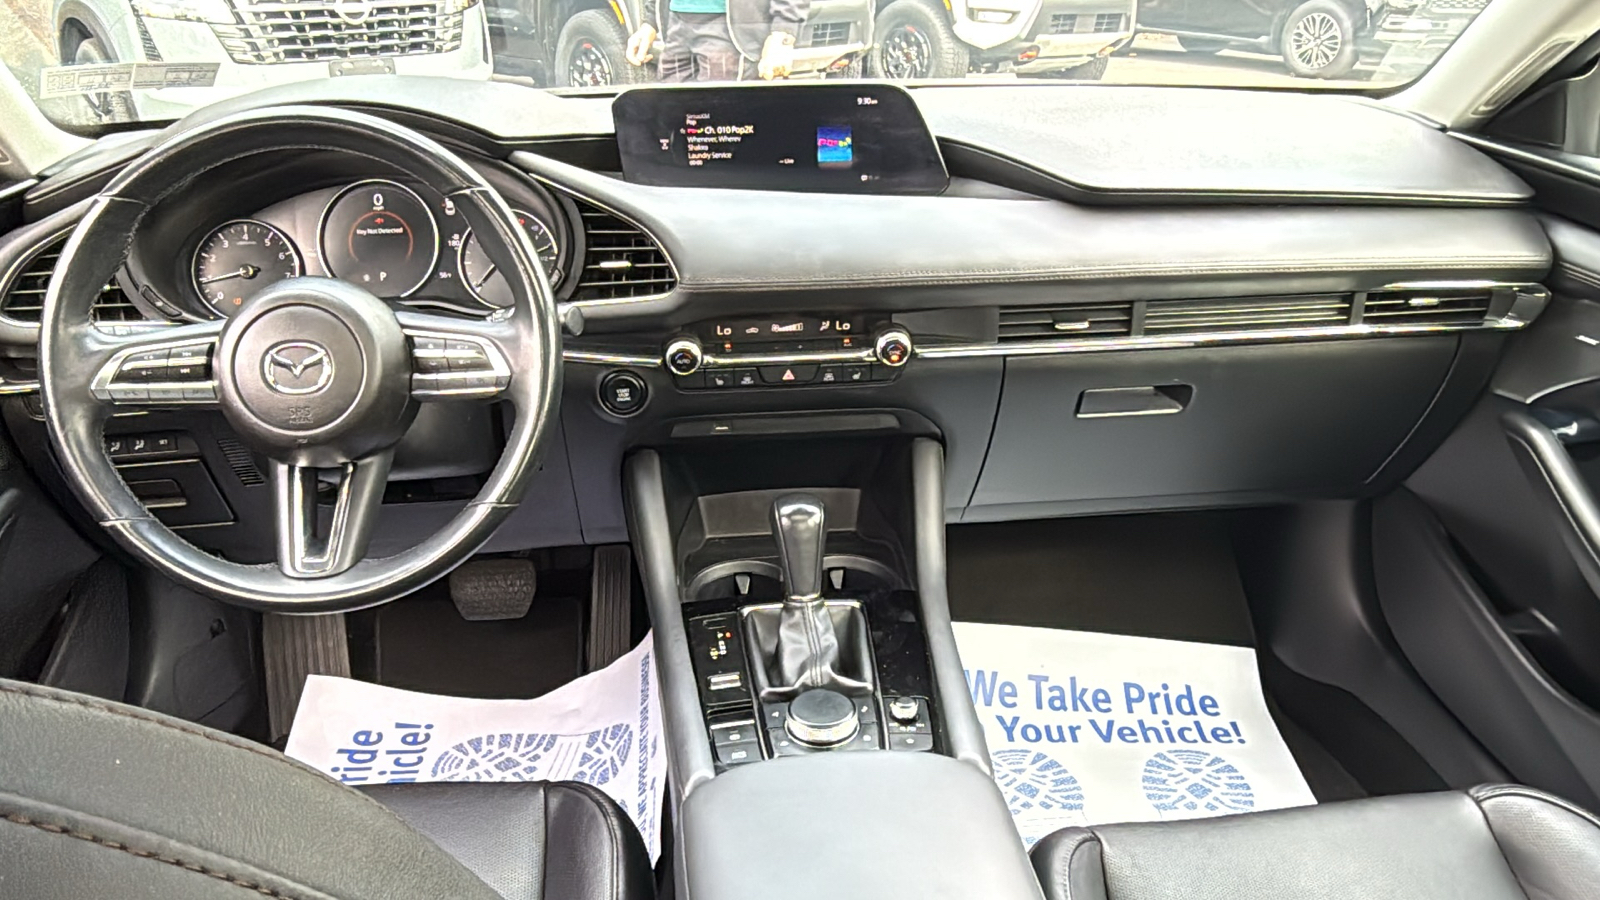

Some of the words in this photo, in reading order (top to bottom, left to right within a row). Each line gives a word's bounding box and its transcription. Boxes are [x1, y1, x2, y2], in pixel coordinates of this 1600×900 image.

[704, 126, 716, 134] Ch.
[717, 126, 731, 134] 010
[732, 125, 754, 135] Pop2K
[688, 152, 711, 160] Laundry
[373, 193, 384, 206] 0
[356, 228, 367, 236] Key
[378, 226, 404, 234] Detected
[242, 233, 249, 241] 4
[222, 240, 229, 248] 3
[264, 238, 271, 247] 5
[210, 254, 216, 262] 2
[278, 252, 285, 260] 6
[380, 271, 387, 281] P
[216, 291, 224, 300] 0
[716, 325, 732, 335] Lo
[835, 320, 851, 331] Lo
[964, 669, 1018, 709] We
[1027, 674, 1113, 714] Take
[1123, 682, 1221, 717] Pride
[640, 701, 649, 736] YOUR
[996, 715, 1082, 743] Your
[1088, 719, 1247, 744] Vehicle!
[331, 730, 384, 782] ride
[378, 722, 434, 783] icle!
[638, 729, 648, 797] APPRECIATE
